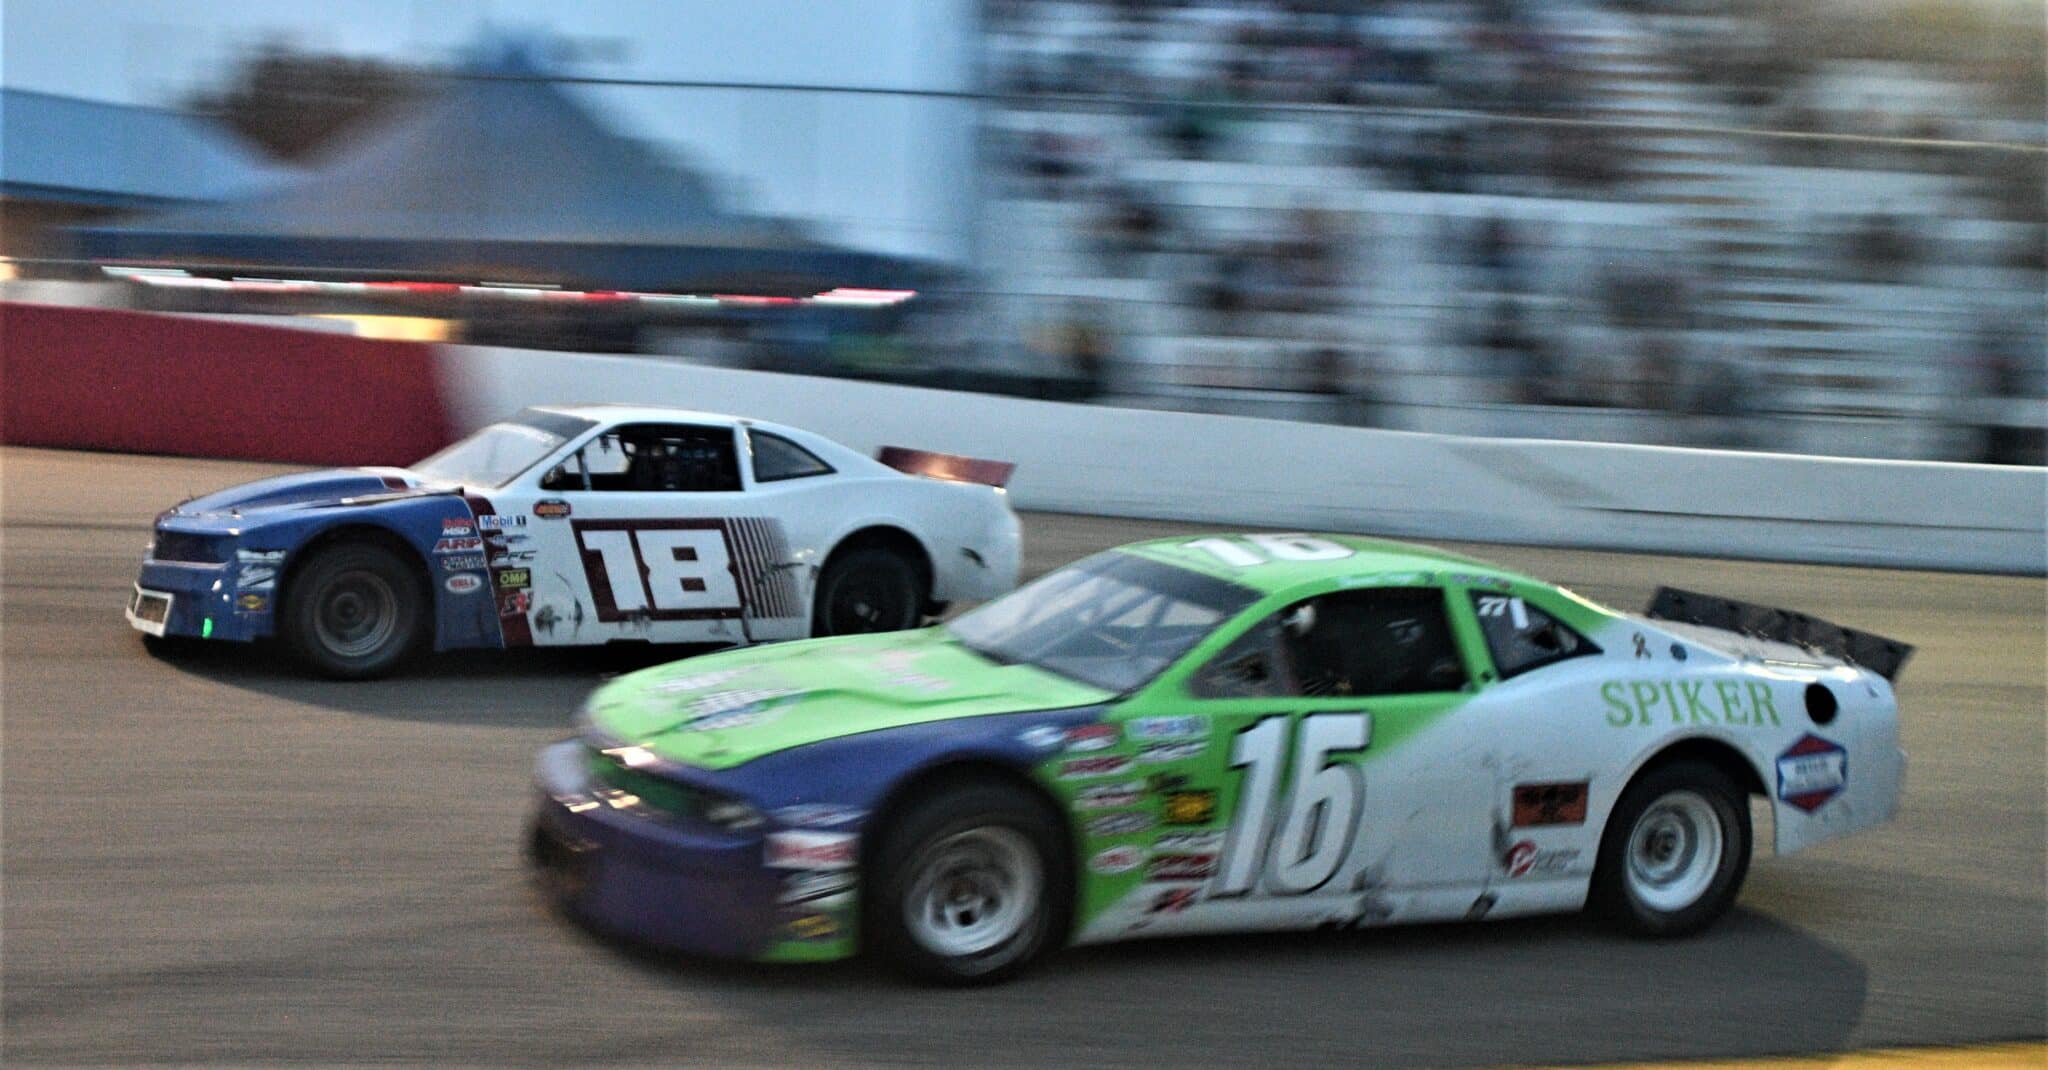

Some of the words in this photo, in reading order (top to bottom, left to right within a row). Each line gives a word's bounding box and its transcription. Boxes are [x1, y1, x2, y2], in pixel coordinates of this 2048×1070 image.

[482, 516, 513, 528] Mobil
[442, 527, 471, 535] MSD
[434, 538, 481, 551] ARP
[580, 529, 742, 611] 18
[500, 572, 528, 585] OMP
[1601, 680, 1781, 728] SPIKER
